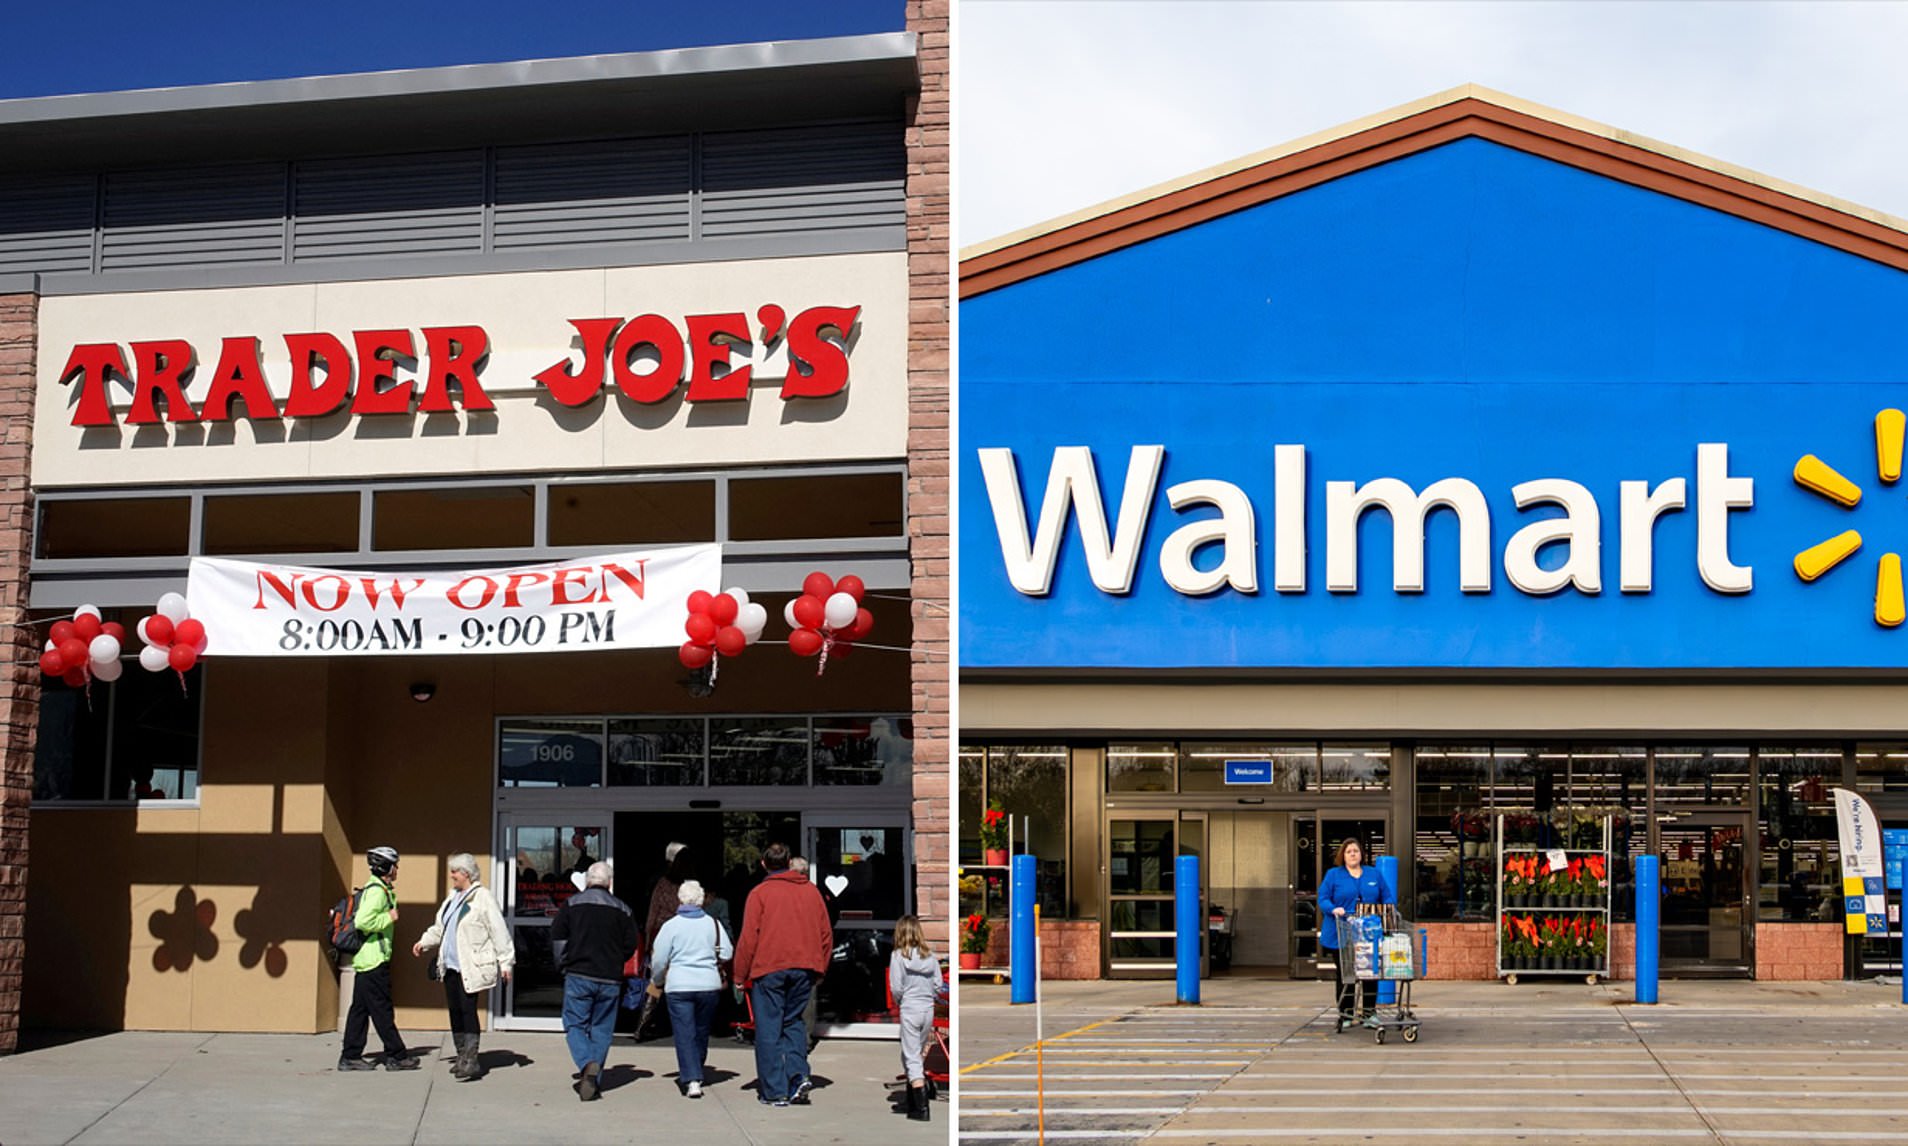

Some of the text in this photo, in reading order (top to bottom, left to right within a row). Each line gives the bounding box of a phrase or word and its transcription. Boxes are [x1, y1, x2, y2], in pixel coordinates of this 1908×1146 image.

[59, 303, 862, 427] TRADER JOE'S
[979, 443, 1755, 596] Walmart
[253, 558, 649, 613] NOW OPEN
[279, 617, 423, 651] 8:00AM
[459, 612, 546, 649] 9:00
[558, 610, 616, 645] PM
[528, 743, 575, 762] 1906
[1234, 768, 1264, 776] Welcome
[1852, 798, 1862, 823] We're
